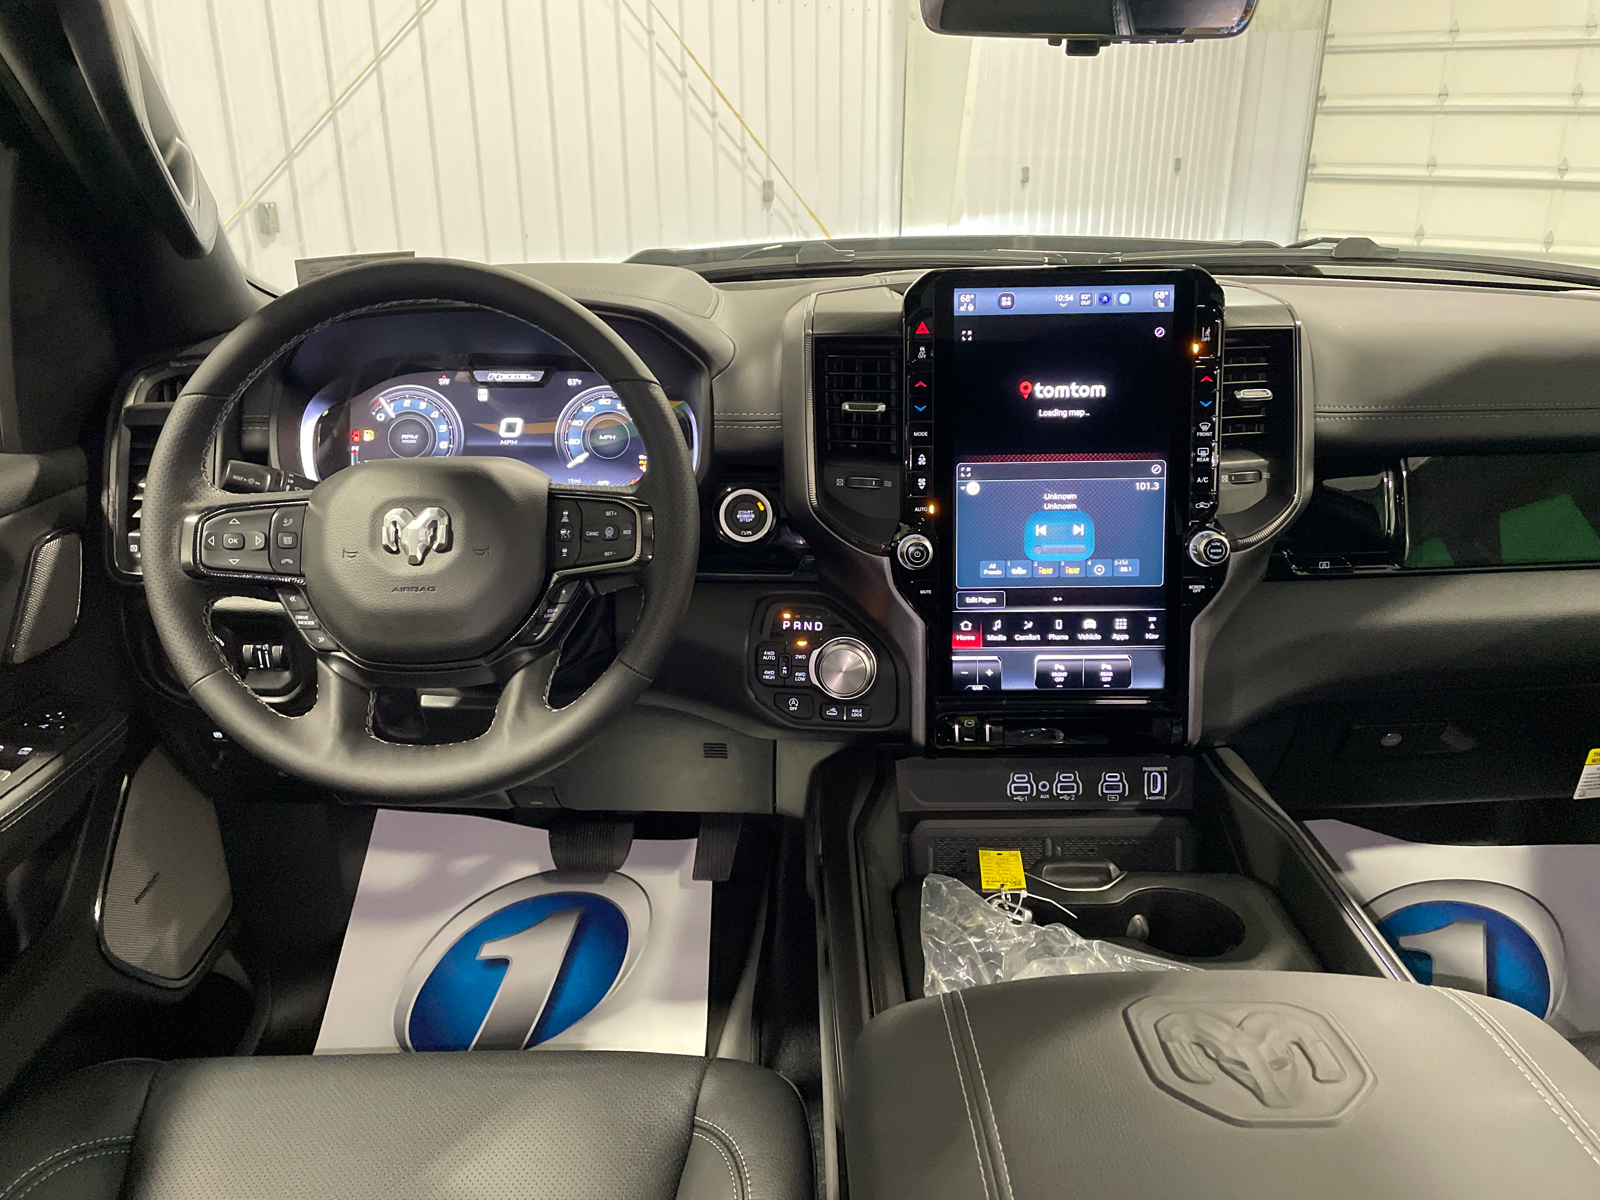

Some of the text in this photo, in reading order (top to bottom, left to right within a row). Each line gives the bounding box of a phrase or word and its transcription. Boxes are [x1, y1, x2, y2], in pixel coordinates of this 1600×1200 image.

[960, 294, 975, 303] 68°
[1055, 294, 1075, 302] 10:54
[1154, 291, 1169, 300] 68°
[1034, 382, 1106, 398] tomtom
[403, 400, 411, 408] 2
[418, 402, 427, 410] 3
[376, 413, 385, 422] 0
[430, 411, 439, 420] 4
[1038, 409, 1067, 419] Loading
[439, 425, 448, 433] 5
[499, 417, 524, 439] 0
[440, 440, 449, 449] 6
[1135, 482, 1160, 491] 101.3
[1044, 493, 1078, 501] Unknown
[1111, 634, 1130, 642] Apps
[475, 907, 586, 1050] 1
